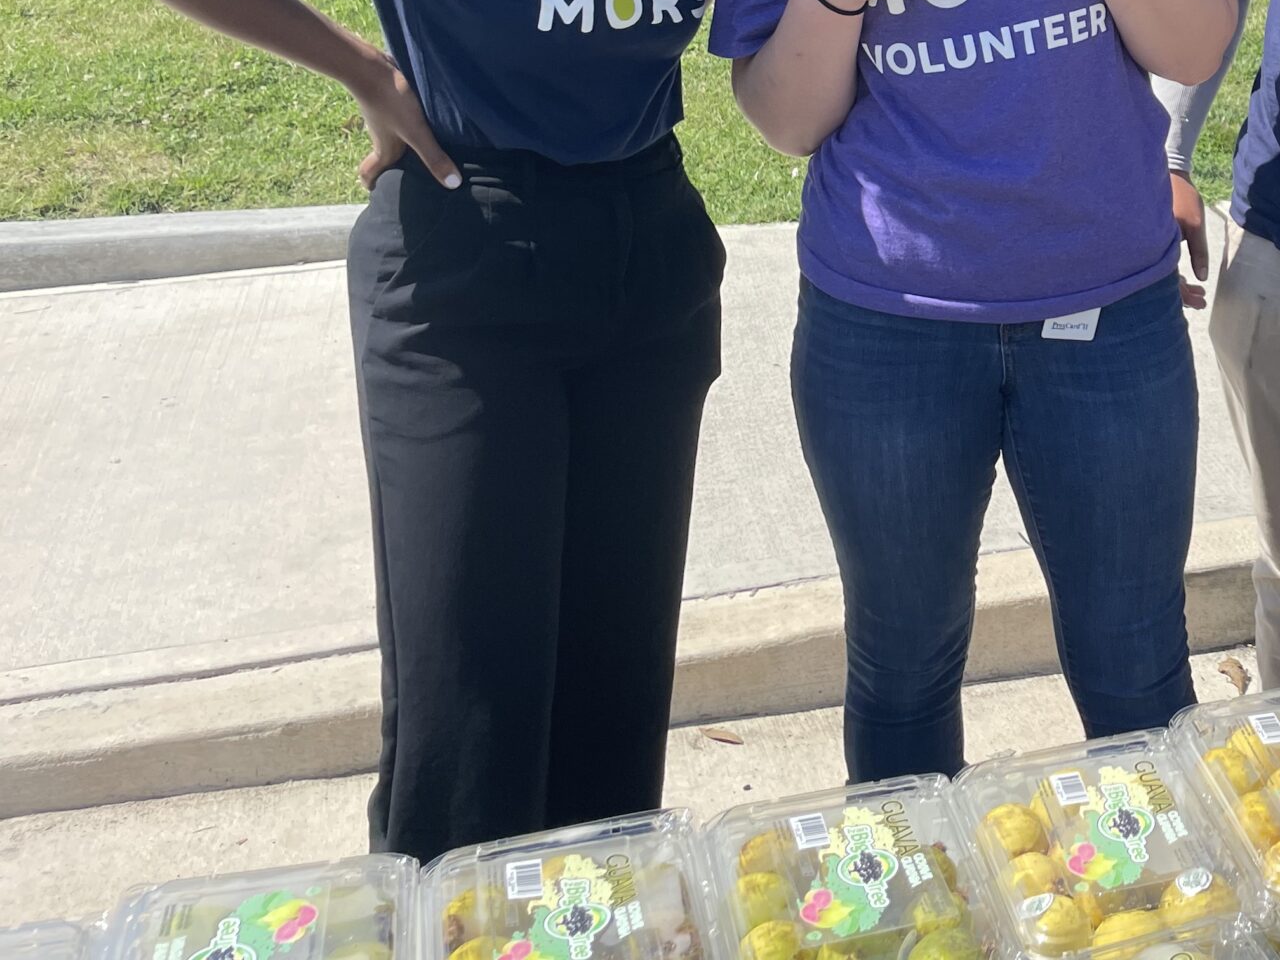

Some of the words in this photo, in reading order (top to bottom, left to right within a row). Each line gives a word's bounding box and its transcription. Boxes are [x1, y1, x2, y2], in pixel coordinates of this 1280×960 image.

[861, 3, 1109, 75] VOLUNTEER
[1134, 760, 1174, 814] GUAVA
[881, 800, 920, 856] GUAVA
[605, 853, 637, 909] GUAVA
